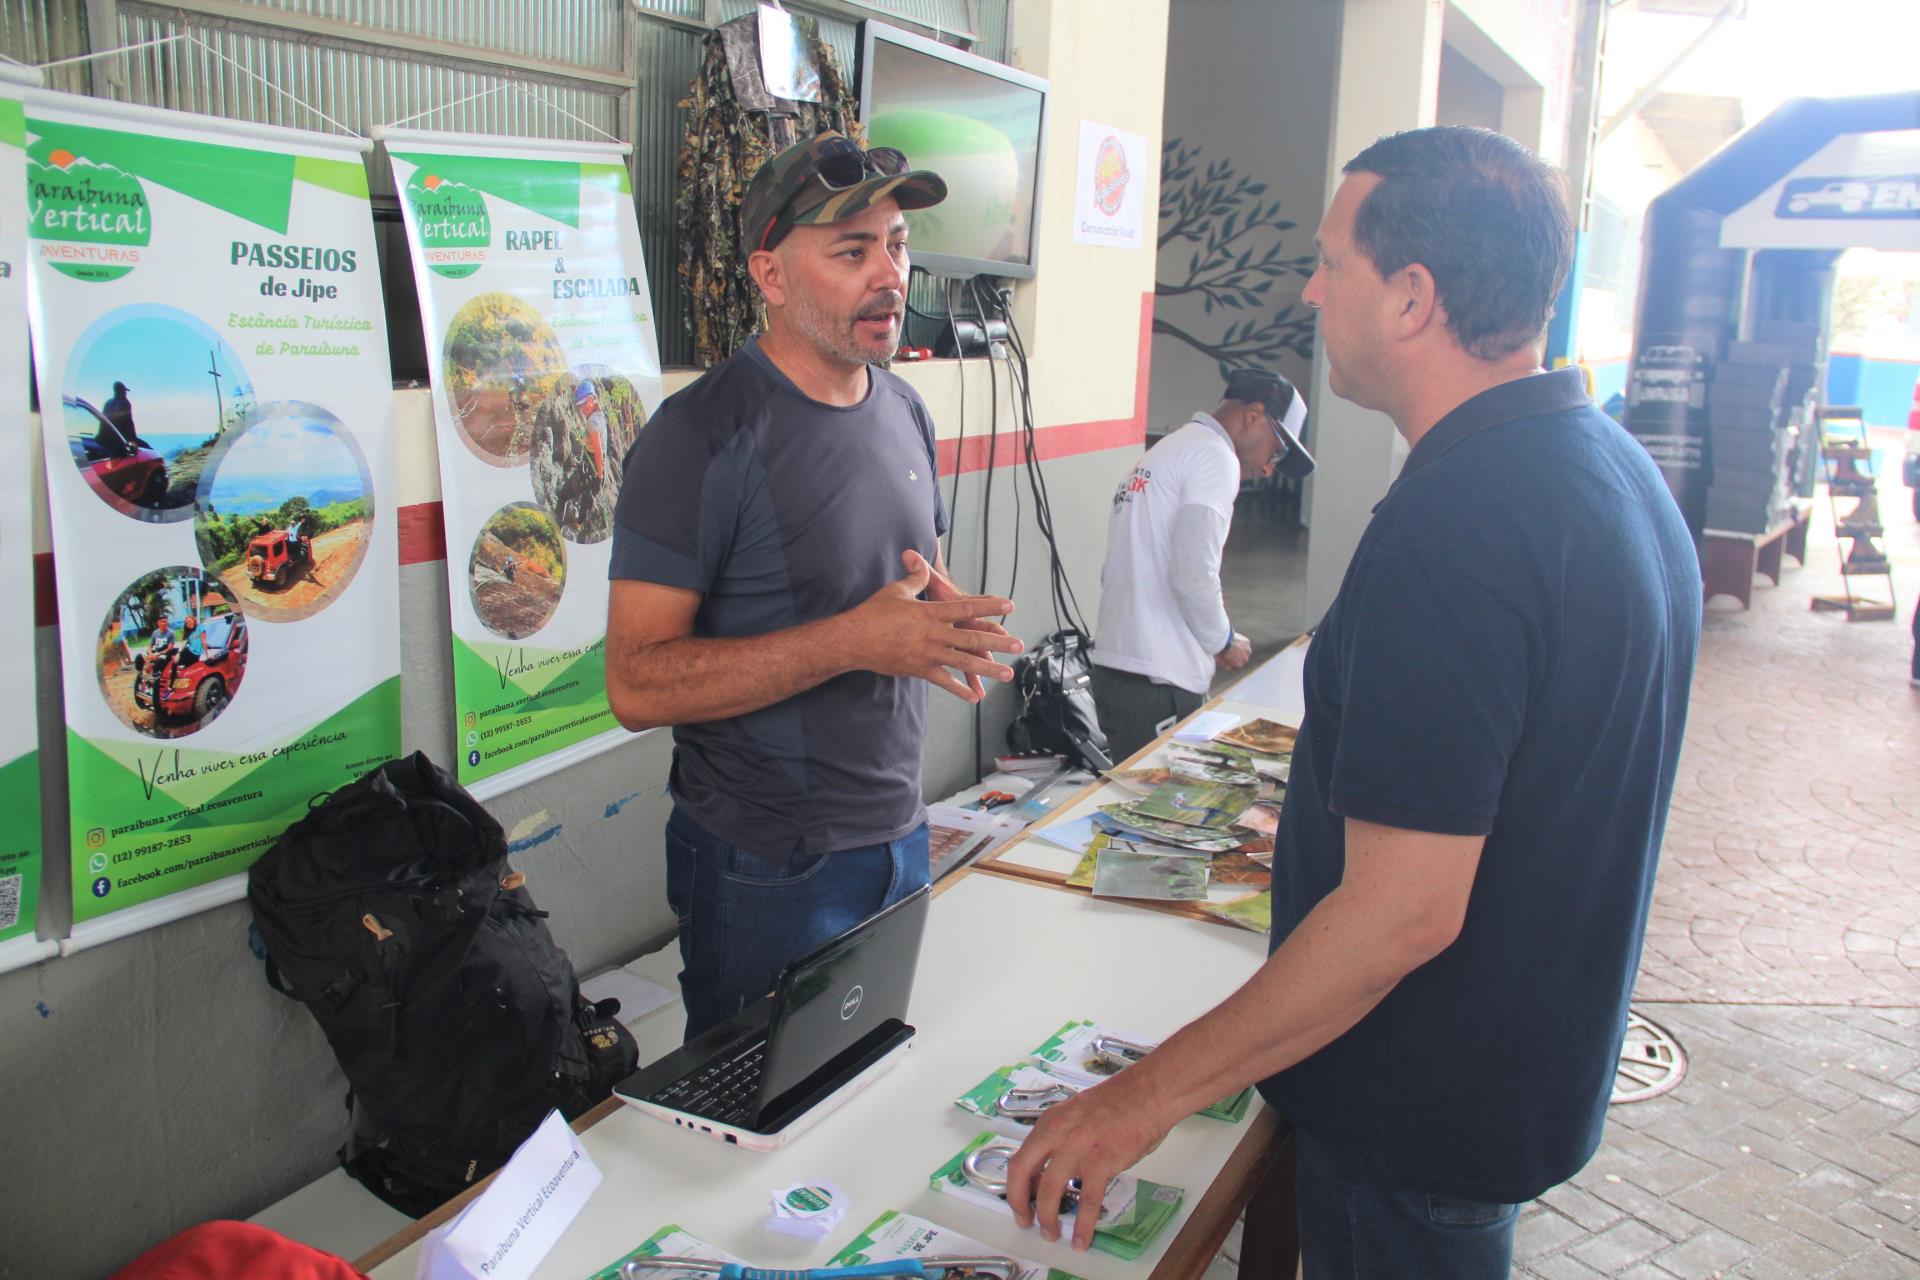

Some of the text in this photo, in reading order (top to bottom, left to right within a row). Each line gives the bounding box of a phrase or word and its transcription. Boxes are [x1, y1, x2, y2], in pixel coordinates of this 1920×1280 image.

[28, 178, 145, 207] araibuna
[505, 230, 563, 251] RAPEL
[230, 241, 357, 273] PASSEIOS
[554, 256, 566, 274] &
[260, 275, 338, 303] de Jipe
[553, 277, 640, 299] ESCALADA
[228, 313, 373, 331] Estância Turística
[256, 341, 275, 356] de
[495, 647, 535, 690] Venha
[585, 639, 605, 657] expe
[480, 729, 494, 741] (12)
[137, 730, 348, 801] Venha viver essa experiência
[110, 789, 263, 839] paraibuna.vertical.ecoaventura
[112, 834, 192, 865] (12) 99187-2853
[117, 834, 282, 889] facebook.com/paraibunaverticalec
[480, 1149, 581, 1276] Paraibuna Vertical Ecoaventura
[912, 1228, 939, 1253] DE JIPE
